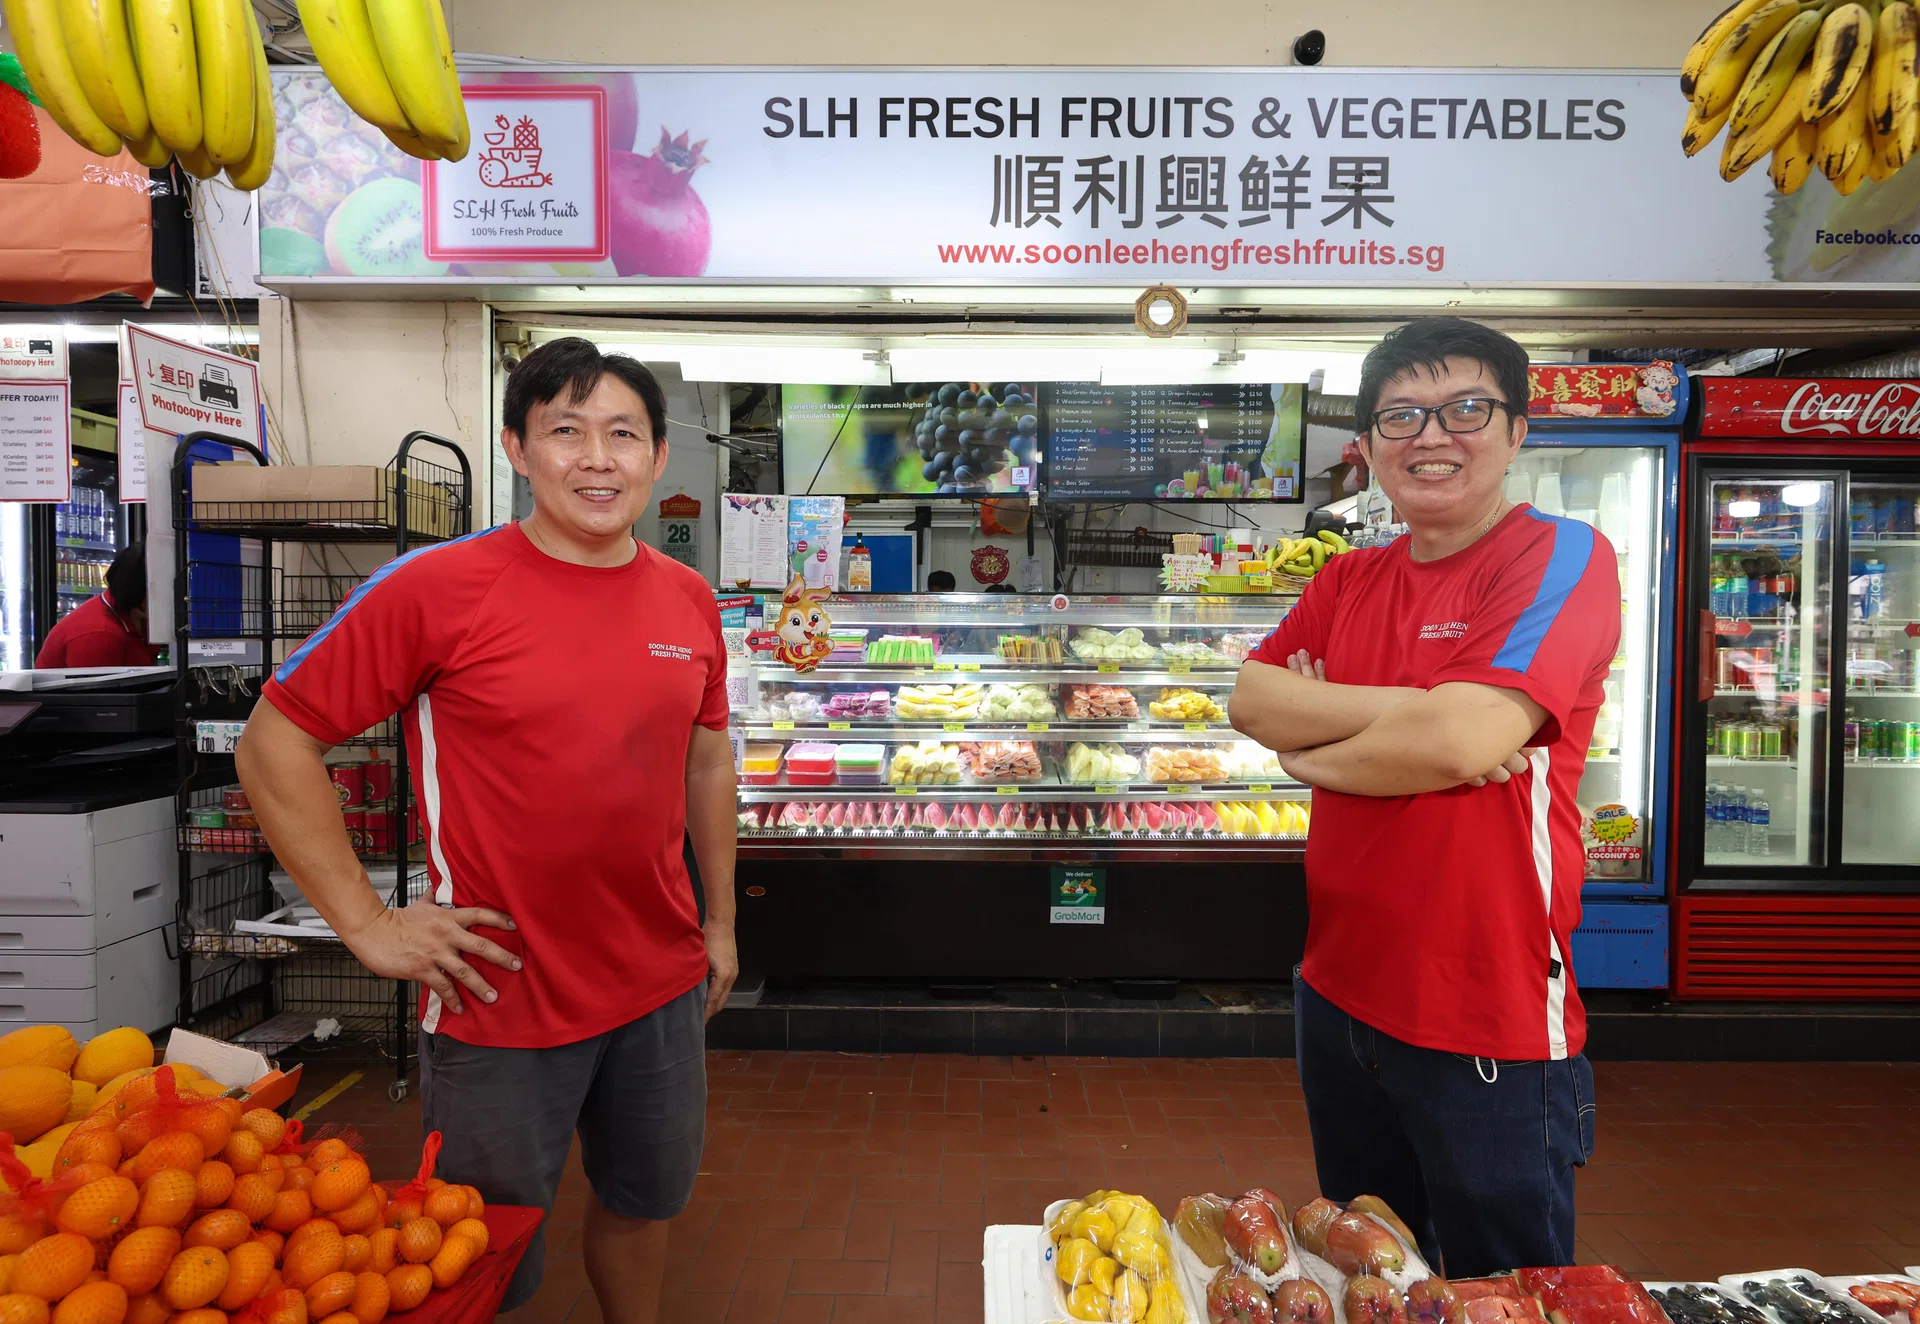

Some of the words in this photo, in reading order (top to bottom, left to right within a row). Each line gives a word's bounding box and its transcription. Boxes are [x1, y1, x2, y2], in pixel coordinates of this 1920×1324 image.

[763, 97, 858, 138] SLH
[880, 97, 1039, 138] FRESH
[1062, 97, 1234, 138] FRUITS
[1252, 97, 1291, 140] &
[1308, 98, 1626, 140] VEGETABLES
[454, 199, 496, 222] SLH
[500, 200, 536, 220] Fresh
[540, 200, 579, 220] Fruits
[471, 228, 497, 236] 100%
[500, 228, 524, 236] Fresh
[526, 228, 563, 236] Produce
[938, 238, 1445, 272] www.soonleehengfreshfruits.sg
[0, 358, 36, 368] hotocopy
[38, 358, 55, 366] Here
[159, 364, 194, 390] 复印
[152, 394, 211, 423] Photocopy
[214, 410, 242, 427] Here
[902, 402, 924, 410] higher
[668, 524, 690, 543] 28
[1871, 576, 1880, 603] ZICO
[672, 652, 691, 661] FRUITS
[1596, 808, 1627, 820] SALE
[1054, 912, 1101, 921] GrabMart
